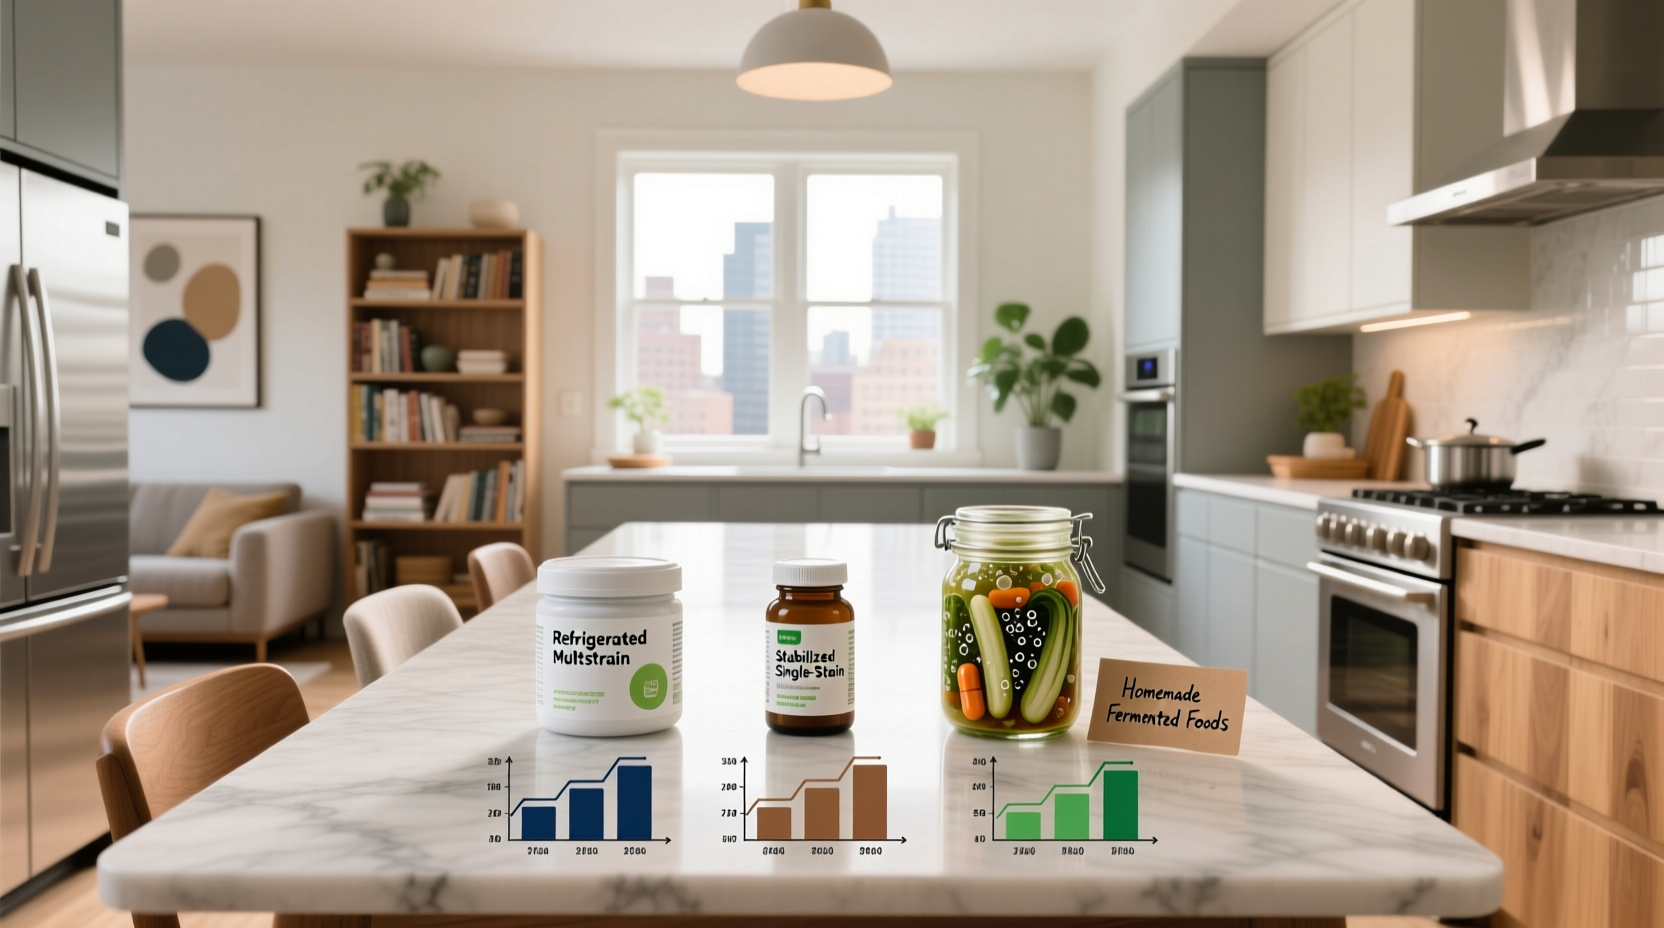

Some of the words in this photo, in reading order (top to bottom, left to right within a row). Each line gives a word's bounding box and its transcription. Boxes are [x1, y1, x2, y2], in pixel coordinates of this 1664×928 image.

[553, 629, 647, 651] Refrigerated
[1121, 676, 1202, 703] Homemade
[1186, 709, 1229, 732] Foods
